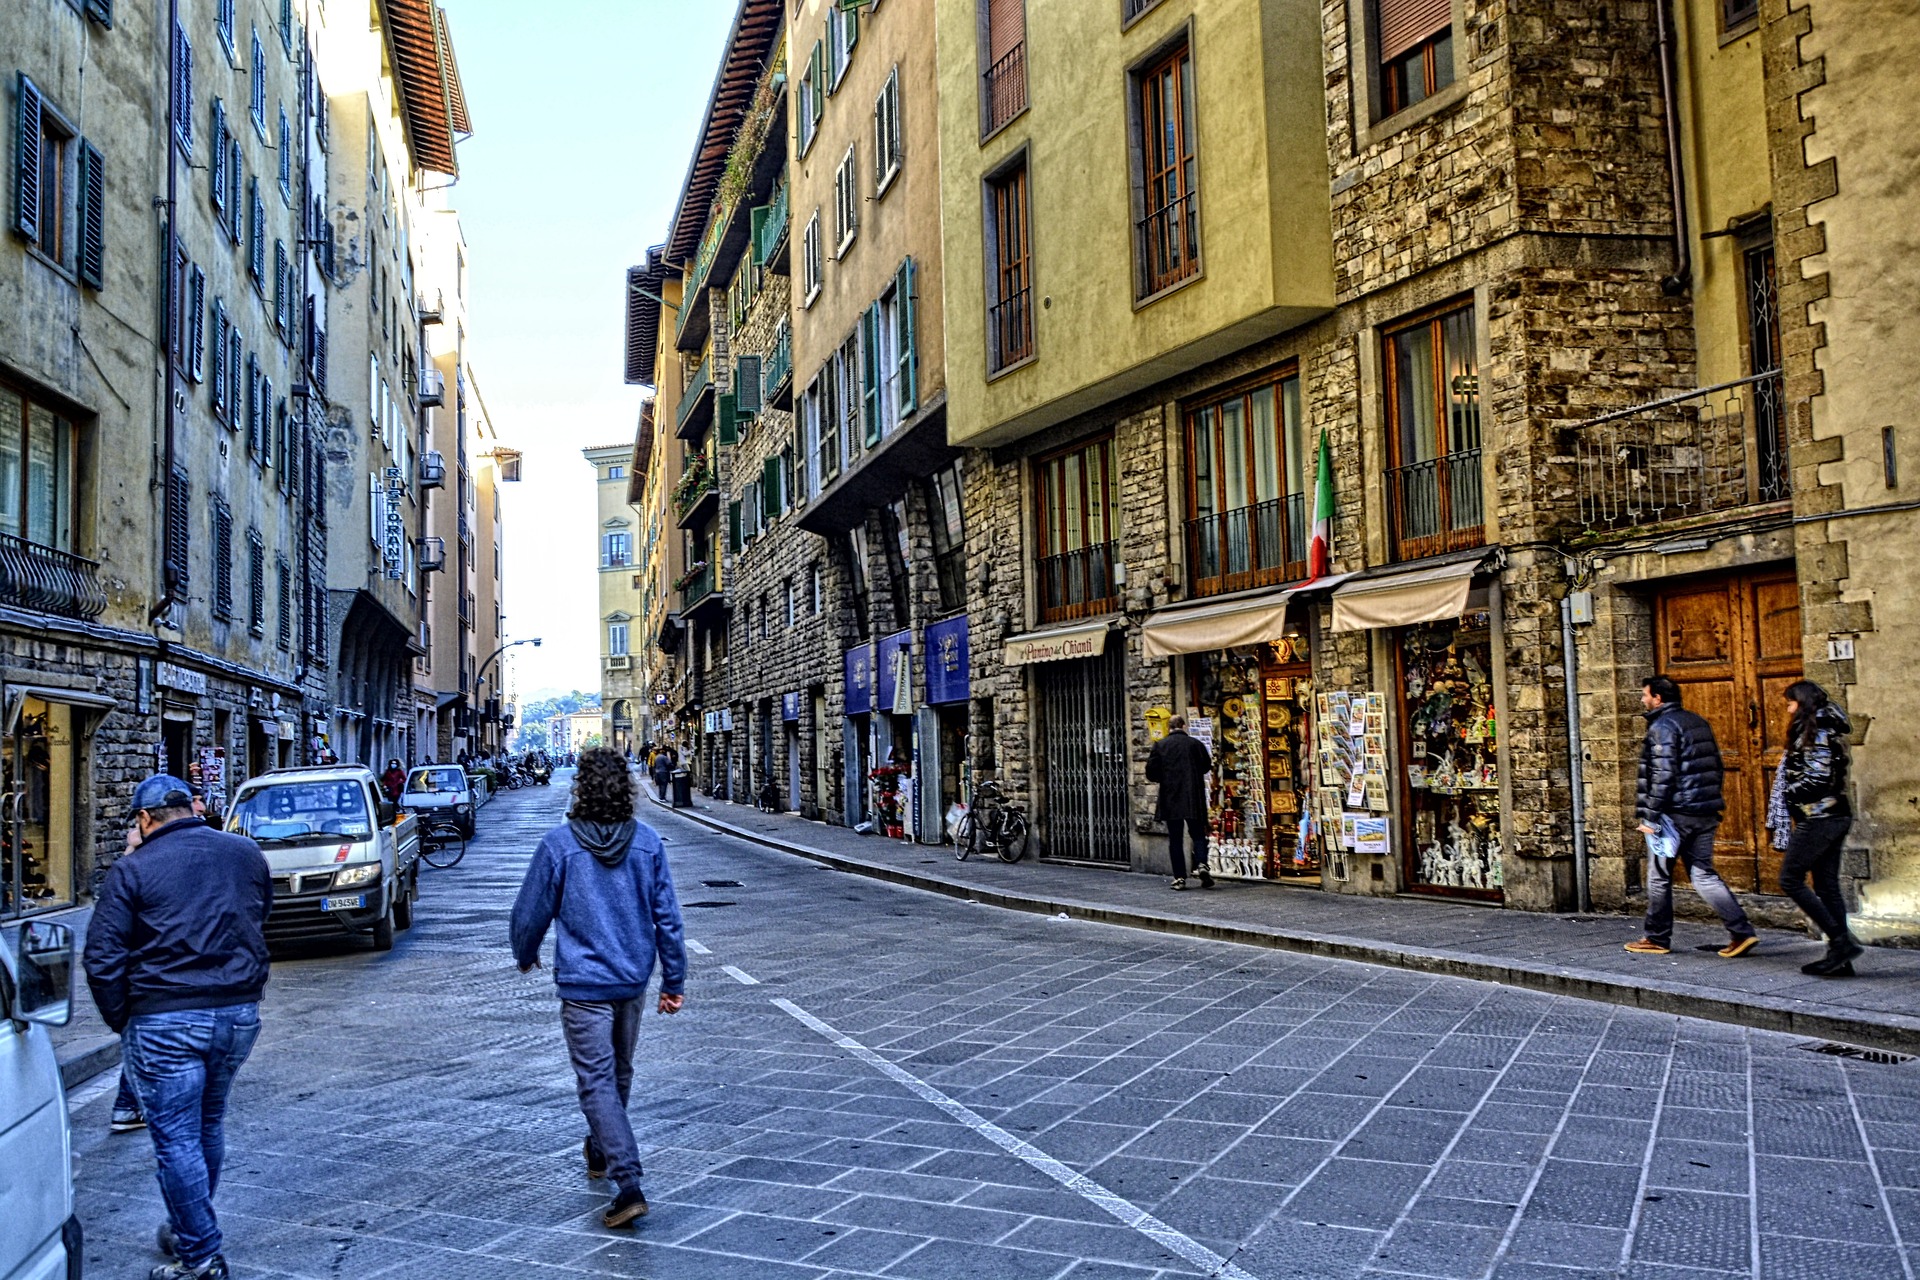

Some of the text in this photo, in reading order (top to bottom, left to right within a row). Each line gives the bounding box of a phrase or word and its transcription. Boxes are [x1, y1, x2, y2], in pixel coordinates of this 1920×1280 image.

[386, 467, 402, 580] RISTORANTE
[1025, 642, 1054, 660] Panino
[1063, 637, 1092, 656] Chianti
[656, 694, 665, 705] P
